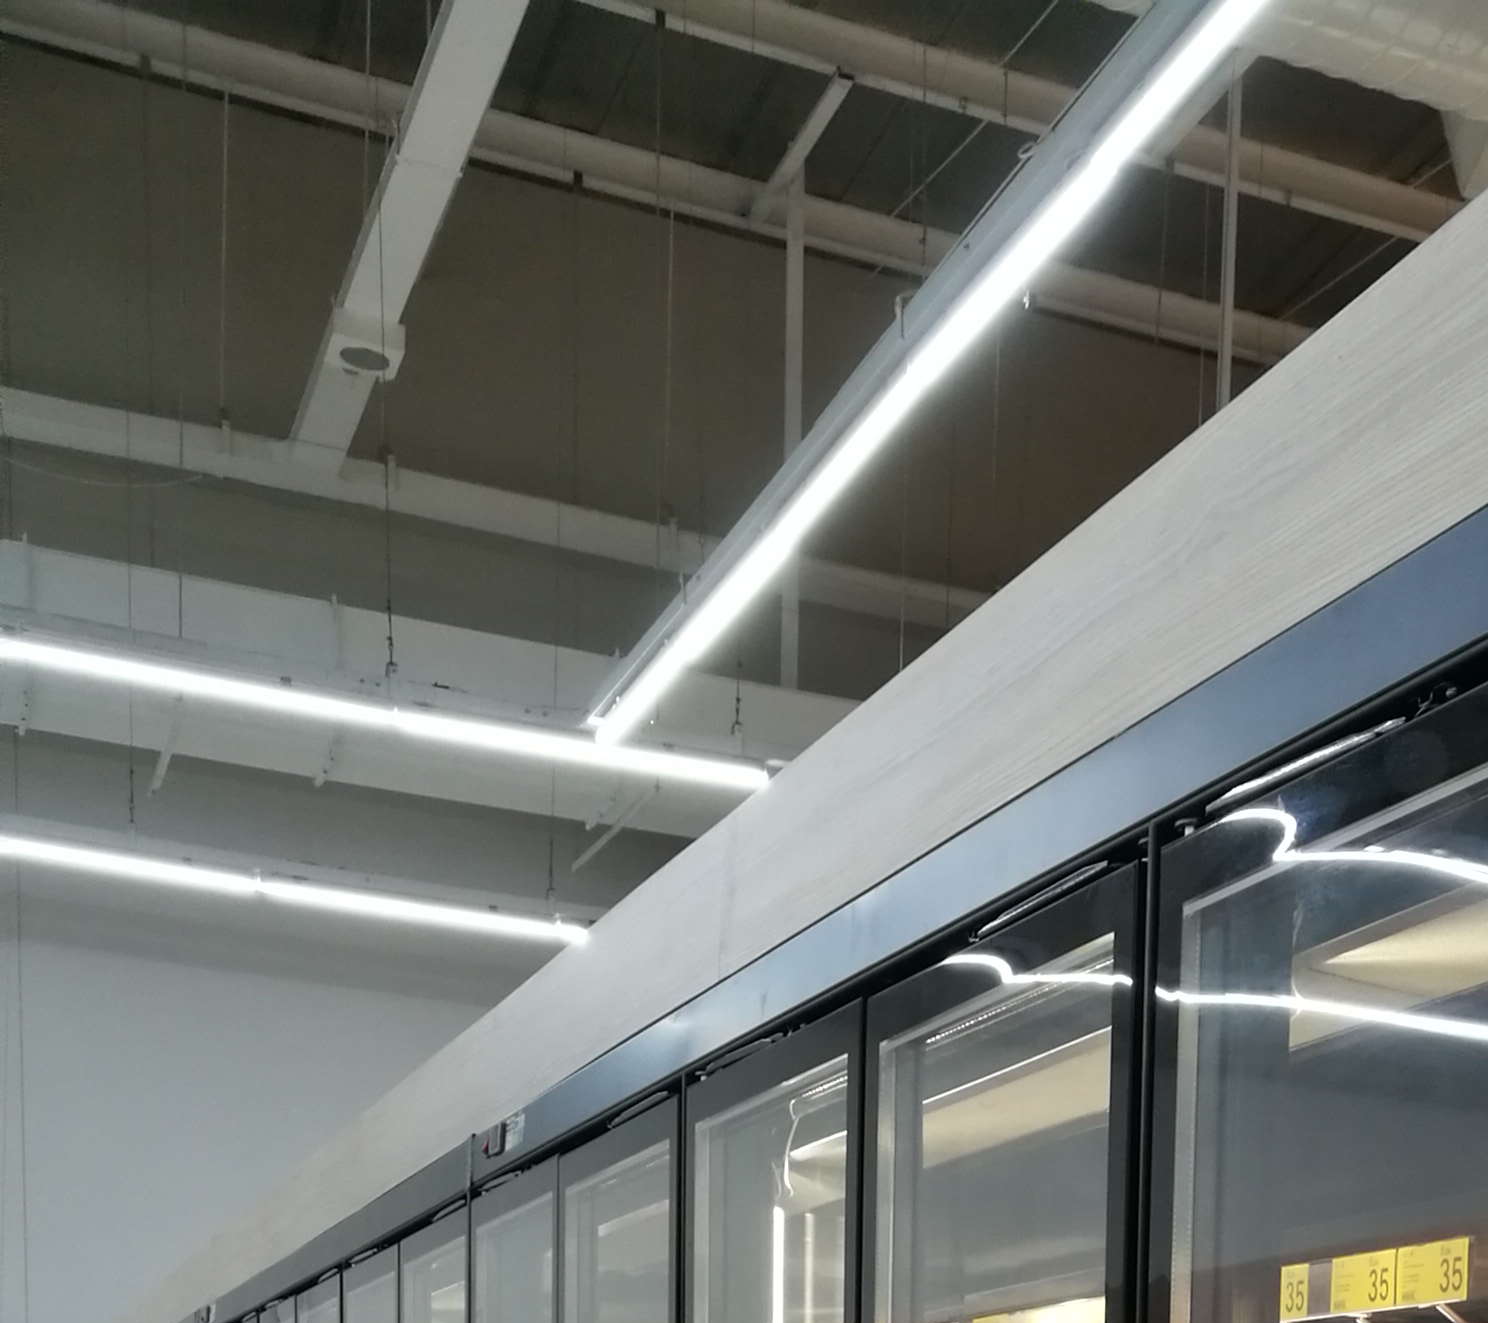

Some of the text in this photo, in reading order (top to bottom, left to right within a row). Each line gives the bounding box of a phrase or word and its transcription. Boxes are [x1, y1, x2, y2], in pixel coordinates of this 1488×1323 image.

[1368, 1267, 1390, 1303] 35
[1440, 1256, 1464, 1293] 35
[1285, 1281, 1305, 1313] 35
